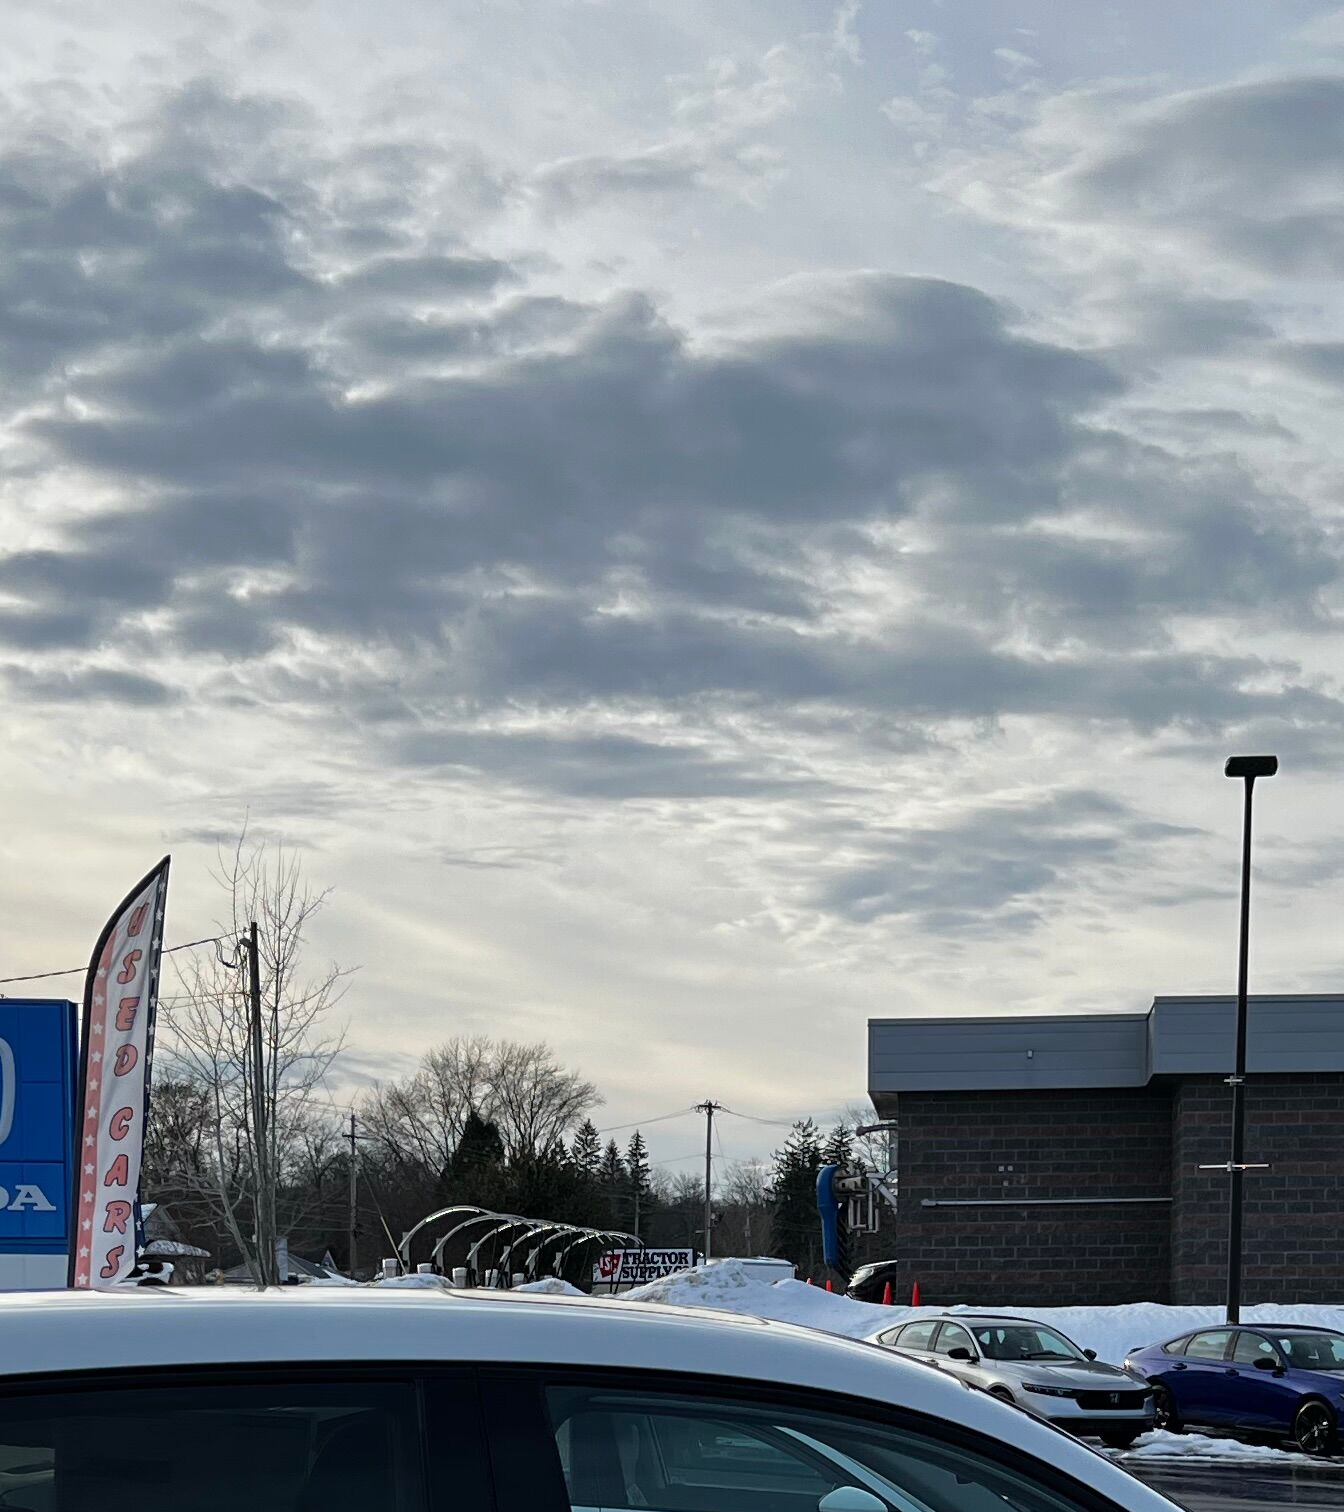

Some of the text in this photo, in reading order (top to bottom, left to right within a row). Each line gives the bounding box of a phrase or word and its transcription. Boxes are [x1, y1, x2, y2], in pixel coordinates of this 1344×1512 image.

[100, 902, 150, 1278] USED CARS
[622, 1252, 690, 1264] TRACTOR
